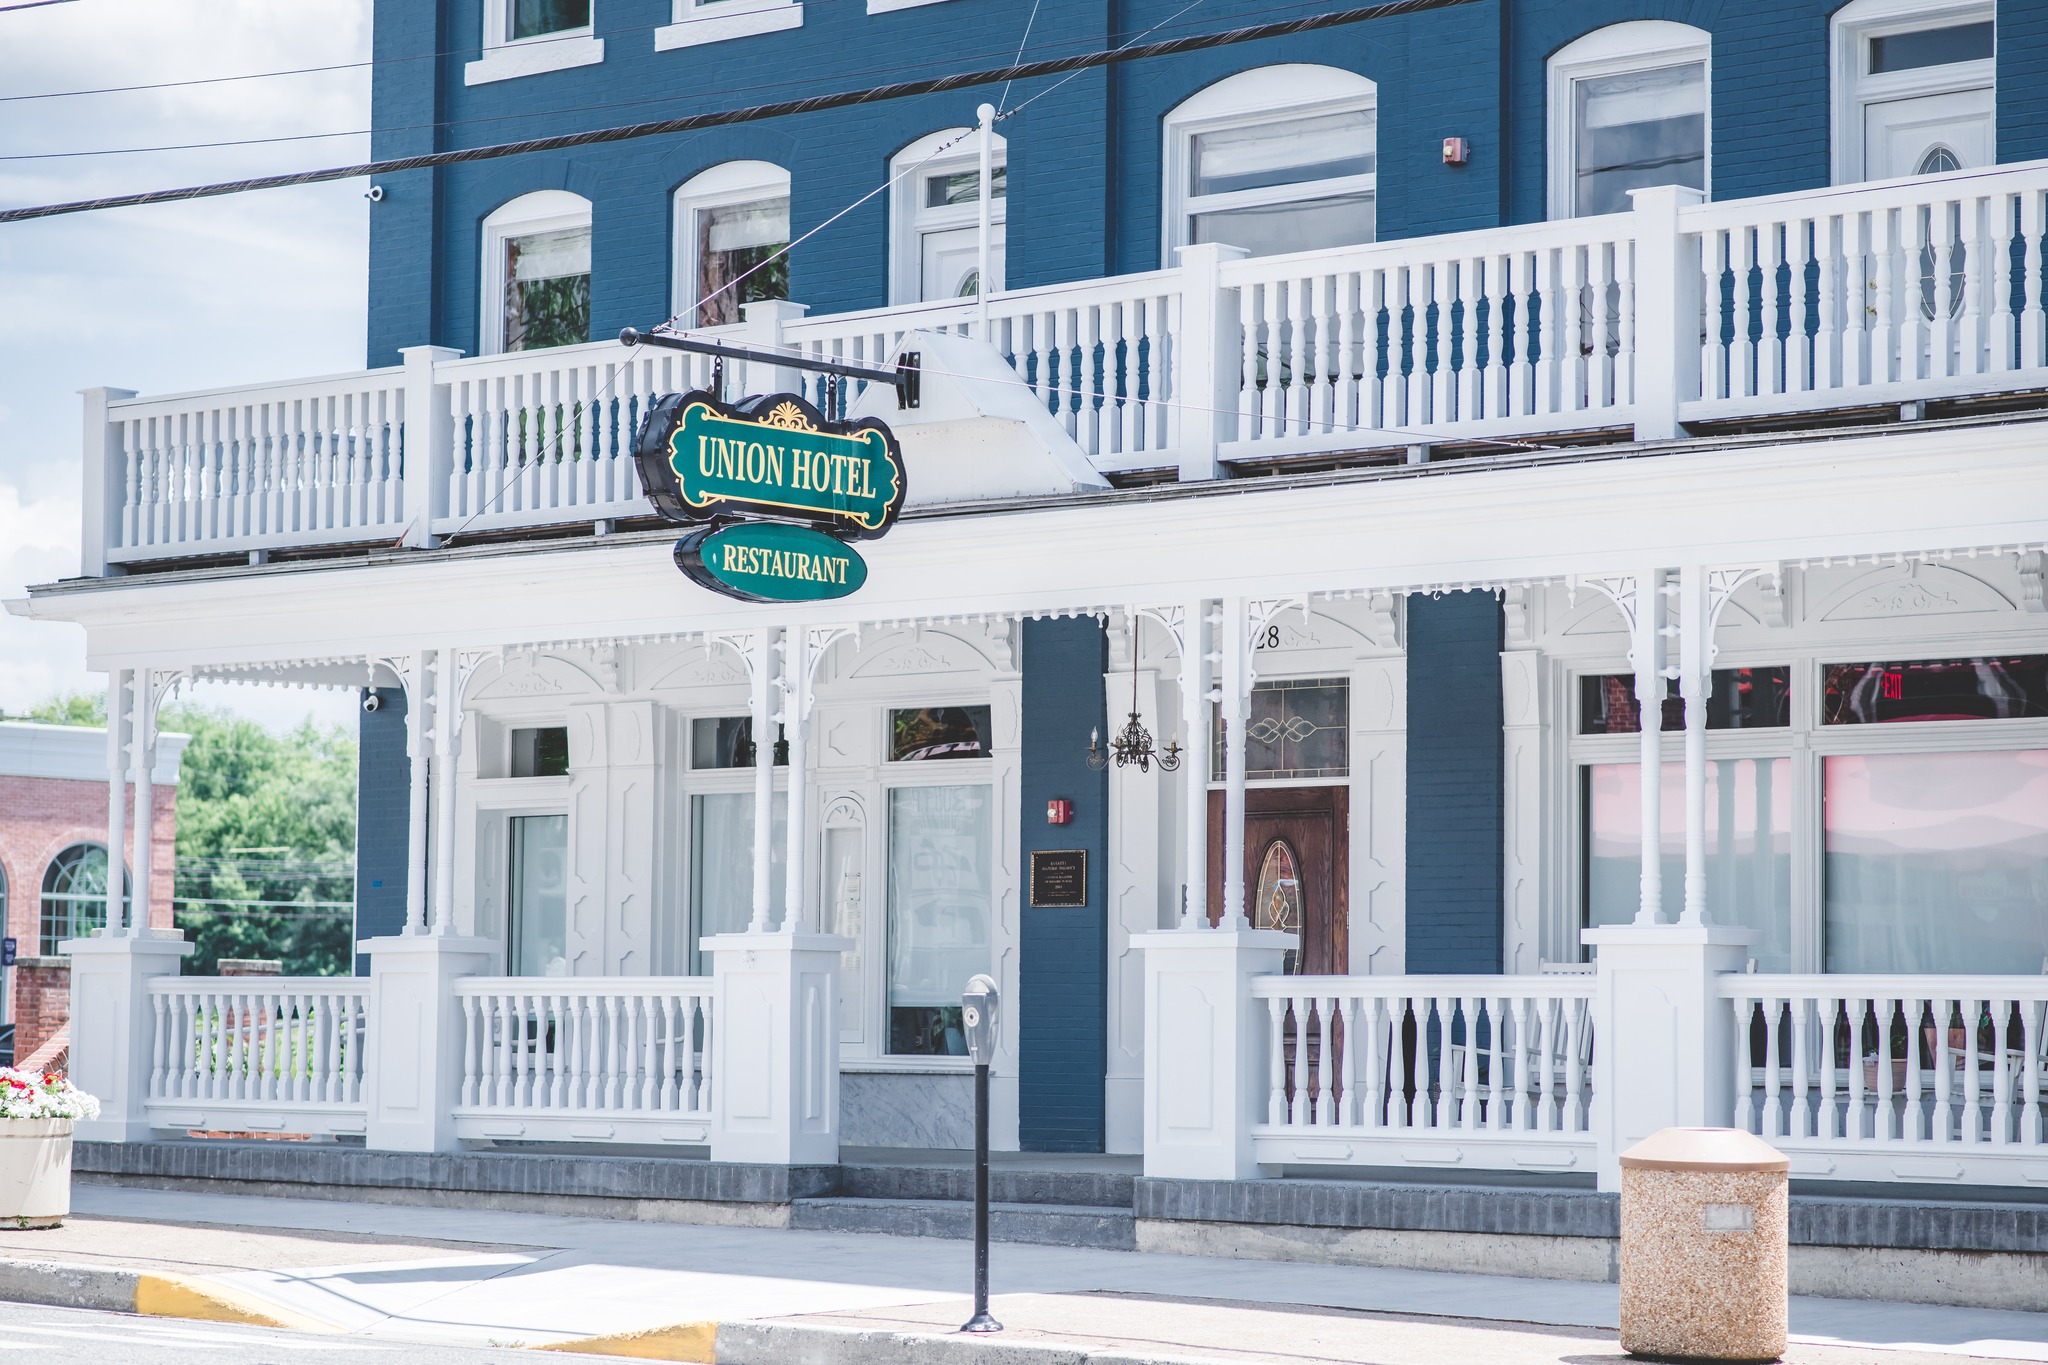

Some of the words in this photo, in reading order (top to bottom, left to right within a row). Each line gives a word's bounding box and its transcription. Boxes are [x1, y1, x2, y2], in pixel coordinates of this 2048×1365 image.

[698, 435, 785, 487] UNION
[791, 448, 876, 498] HOTEL
[722, 544, 850, 584] RESTAURANT
[1884, 671, 1903, 700] EXIT
